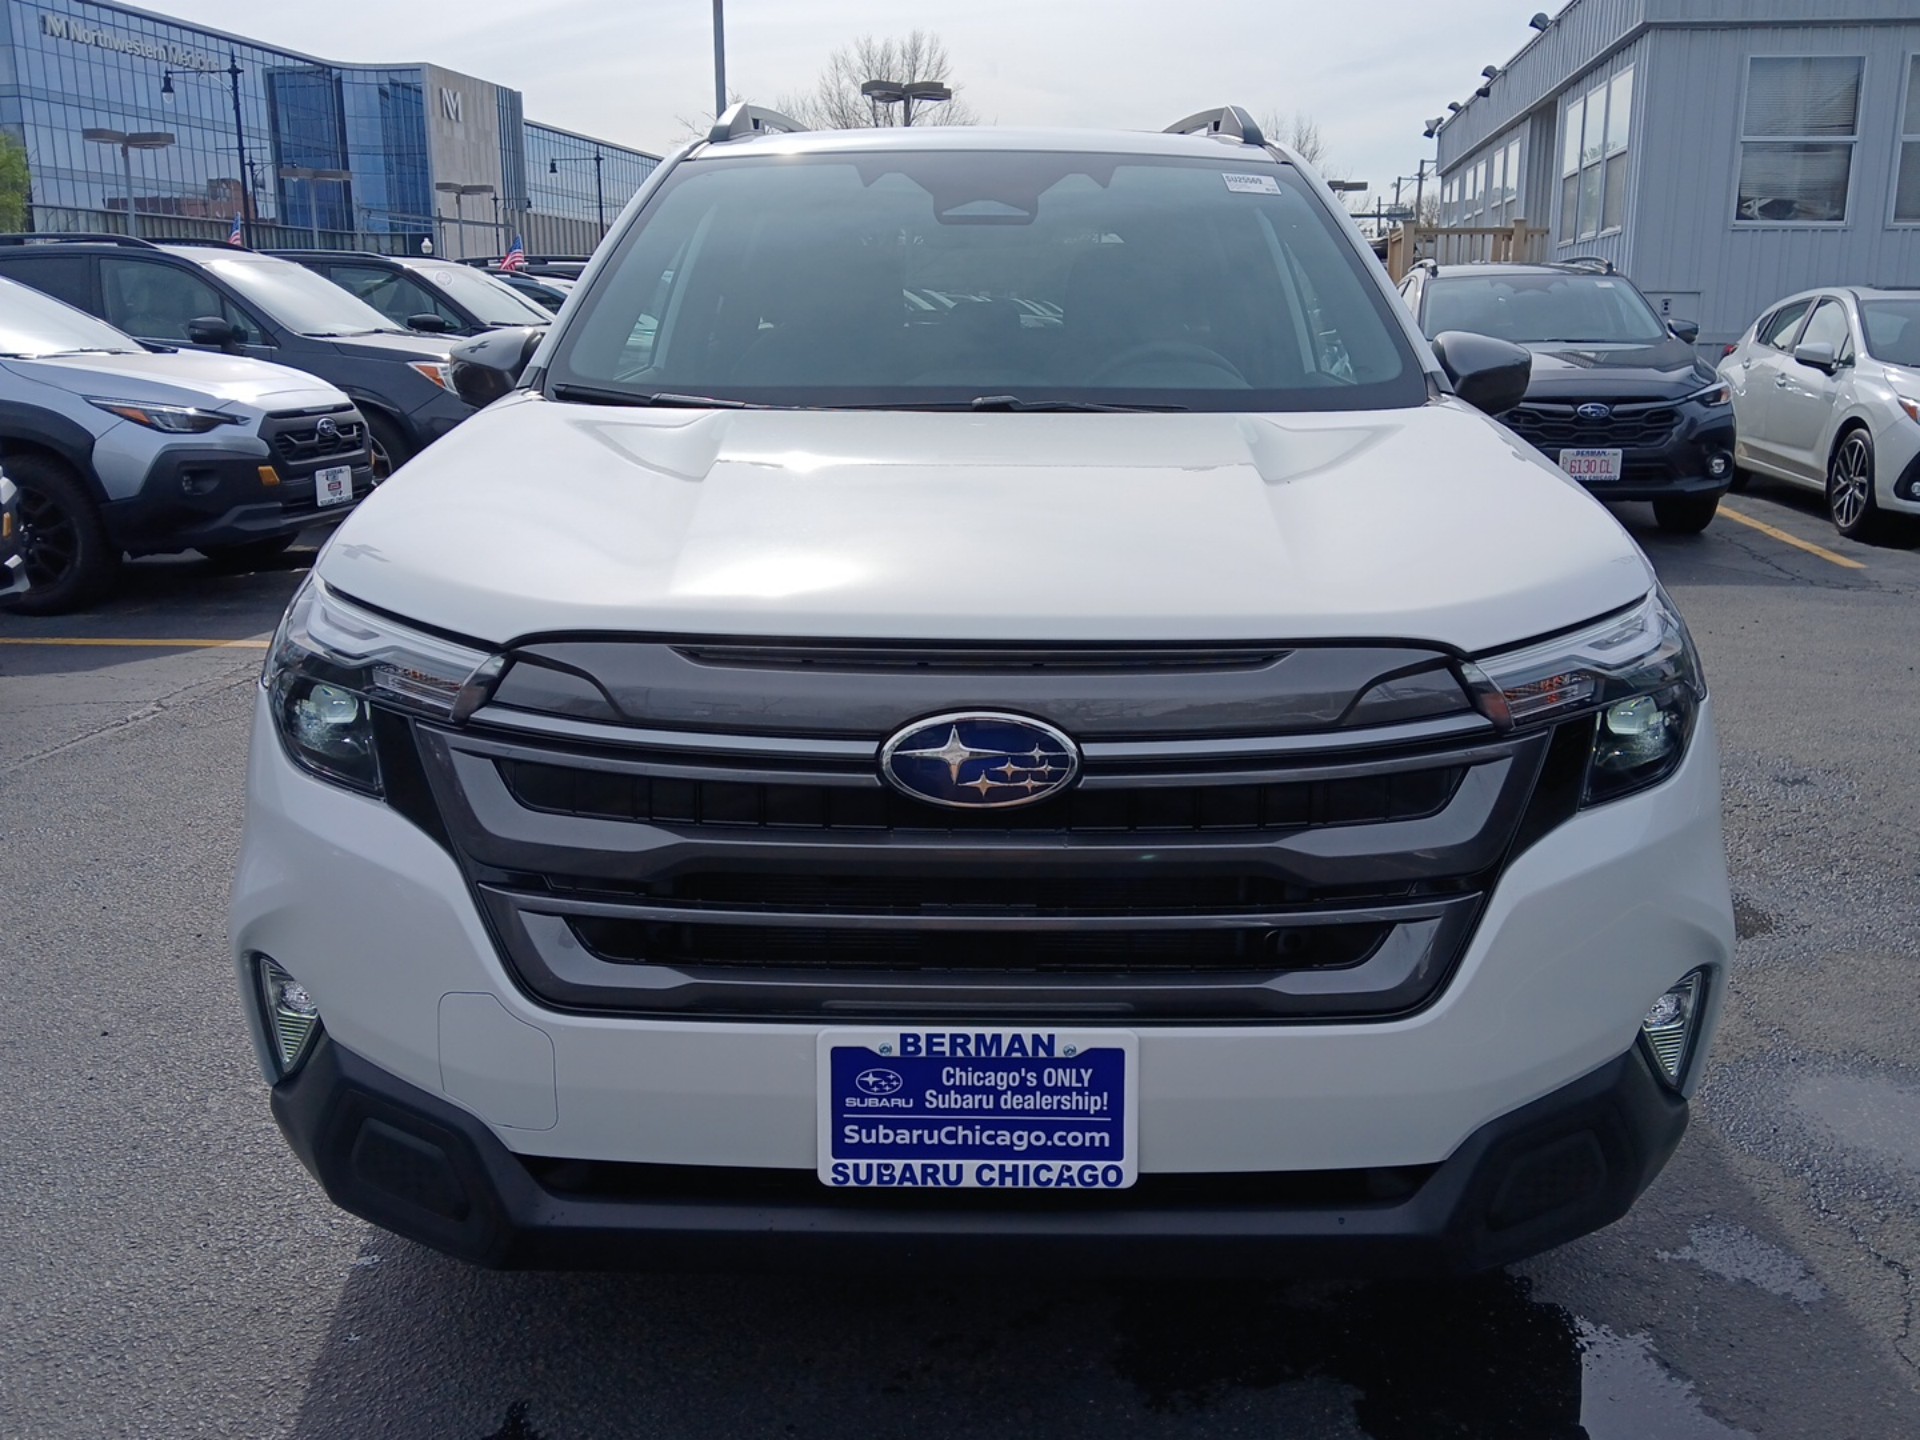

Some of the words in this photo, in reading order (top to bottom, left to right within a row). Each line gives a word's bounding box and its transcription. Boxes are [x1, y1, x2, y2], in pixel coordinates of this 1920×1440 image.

[70, 21, 167, 61] Northwestern
[1569, 459, 1597, 474] 6130
[899, 1033, 1056, 1057] BERMAN
[942, 1067, 1037, 1089] Chicago's
[1043, 1068, 1093, 1087] ONLY
[845, 1097, 913, 1108] SUBARU
[925, 1090, 994, 1109] Subaru
[1000, 1091, 1108, 1114] dealership!
[844, 1125, 1110, 1151] SubaruChicago.com
[831, 1163, 963, 1186] SUBARU
[975, 1164, 1123, 1187] CHICAGO
